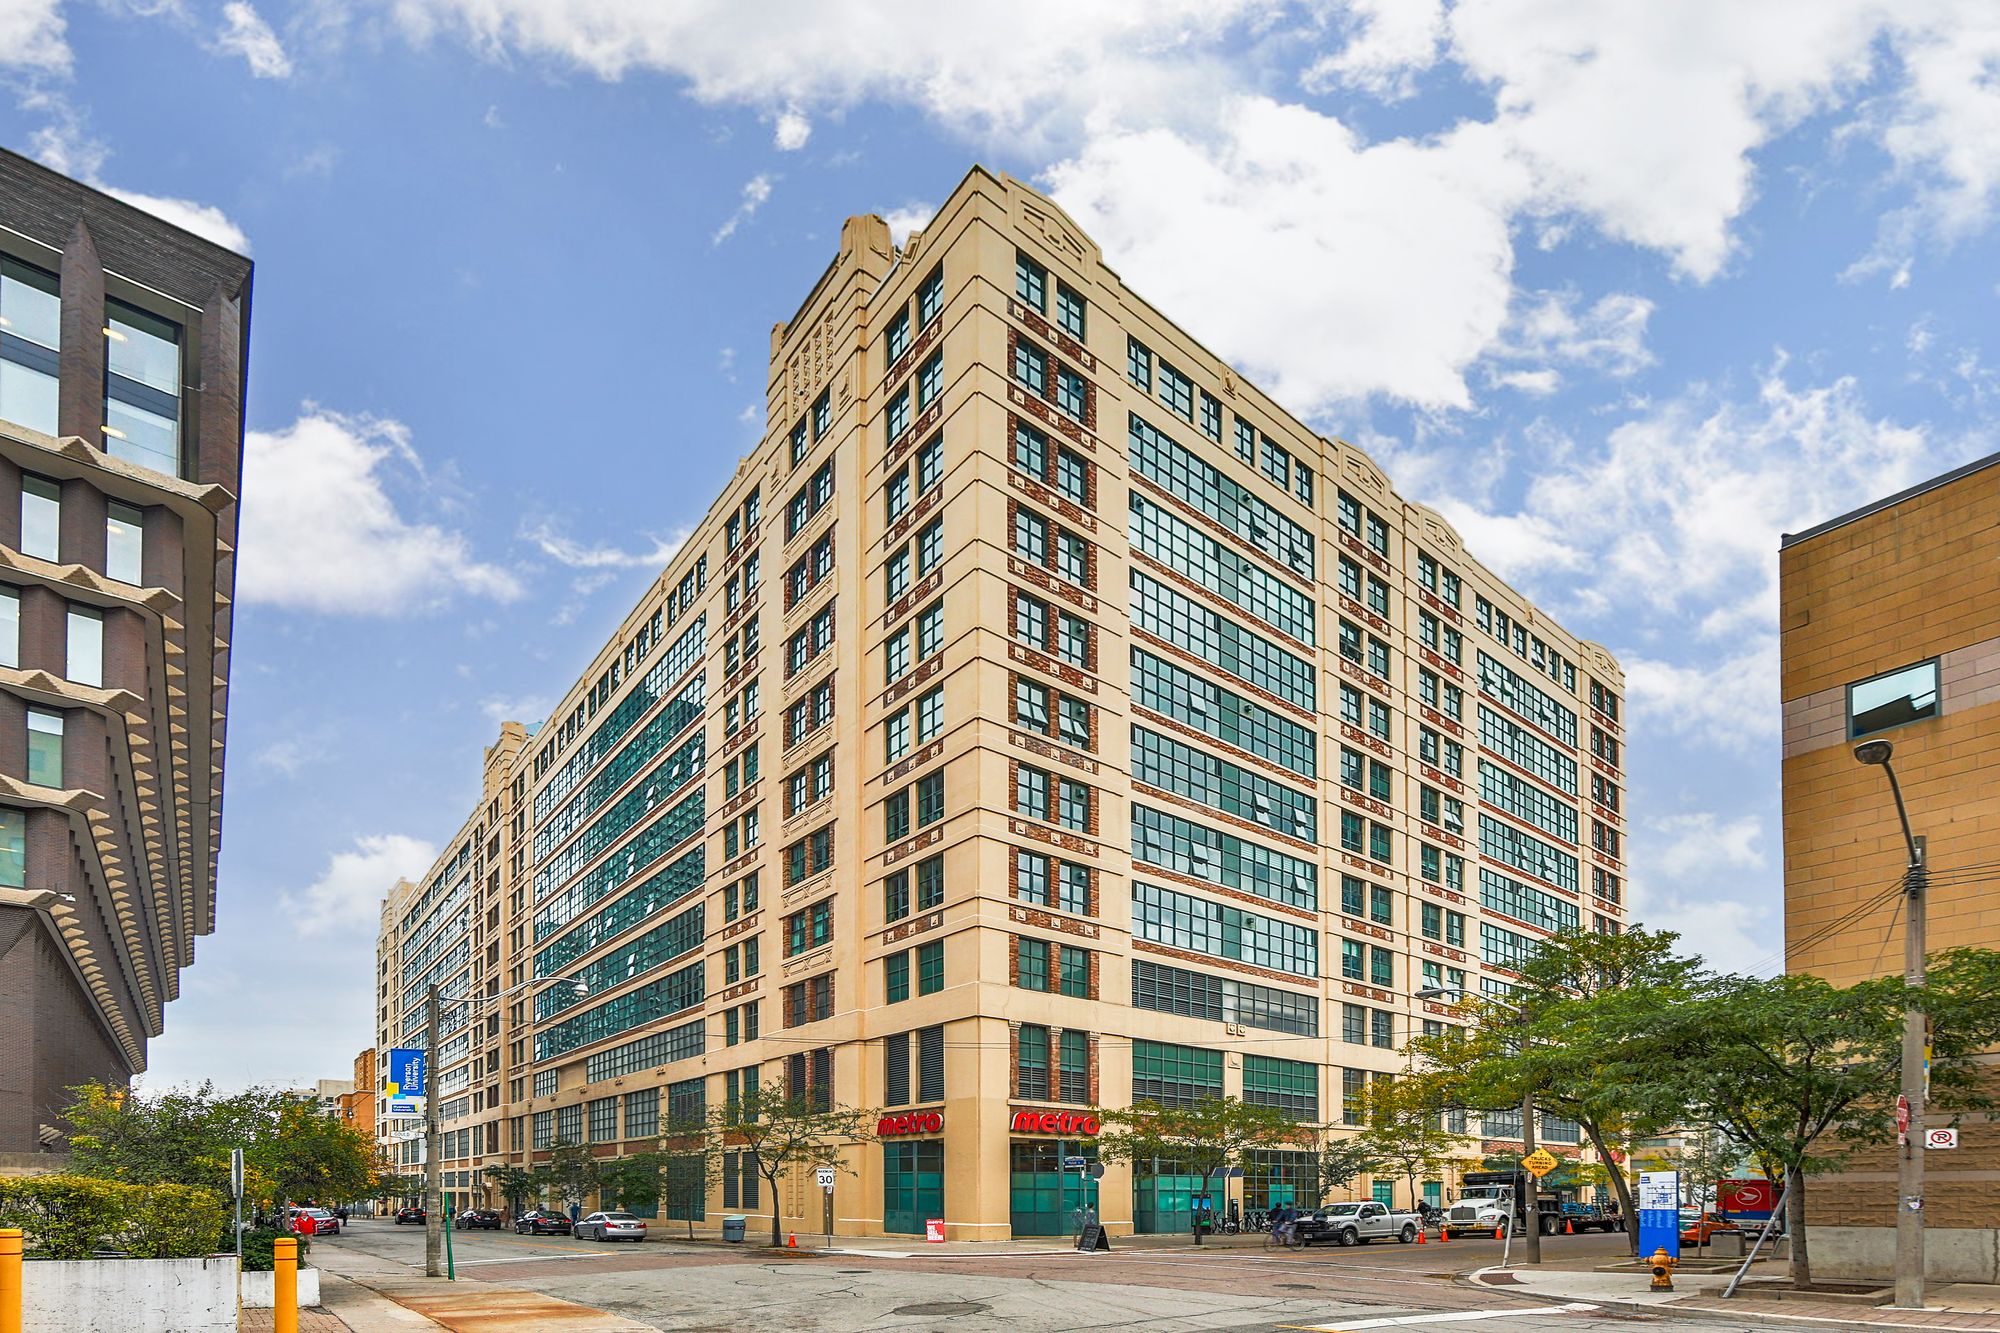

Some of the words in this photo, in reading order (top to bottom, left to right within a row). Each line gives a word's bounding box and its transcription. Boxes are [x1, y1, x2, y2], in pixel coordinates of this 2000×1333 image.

[403, 1063, 411, 1090] Ryerson
[411, 1057, 421, 1090] University
[877, 1112, 944, 1136] metro
[1010, 1111, 1100, 1135] metro
[819, 1175, 832, 1184] 30
